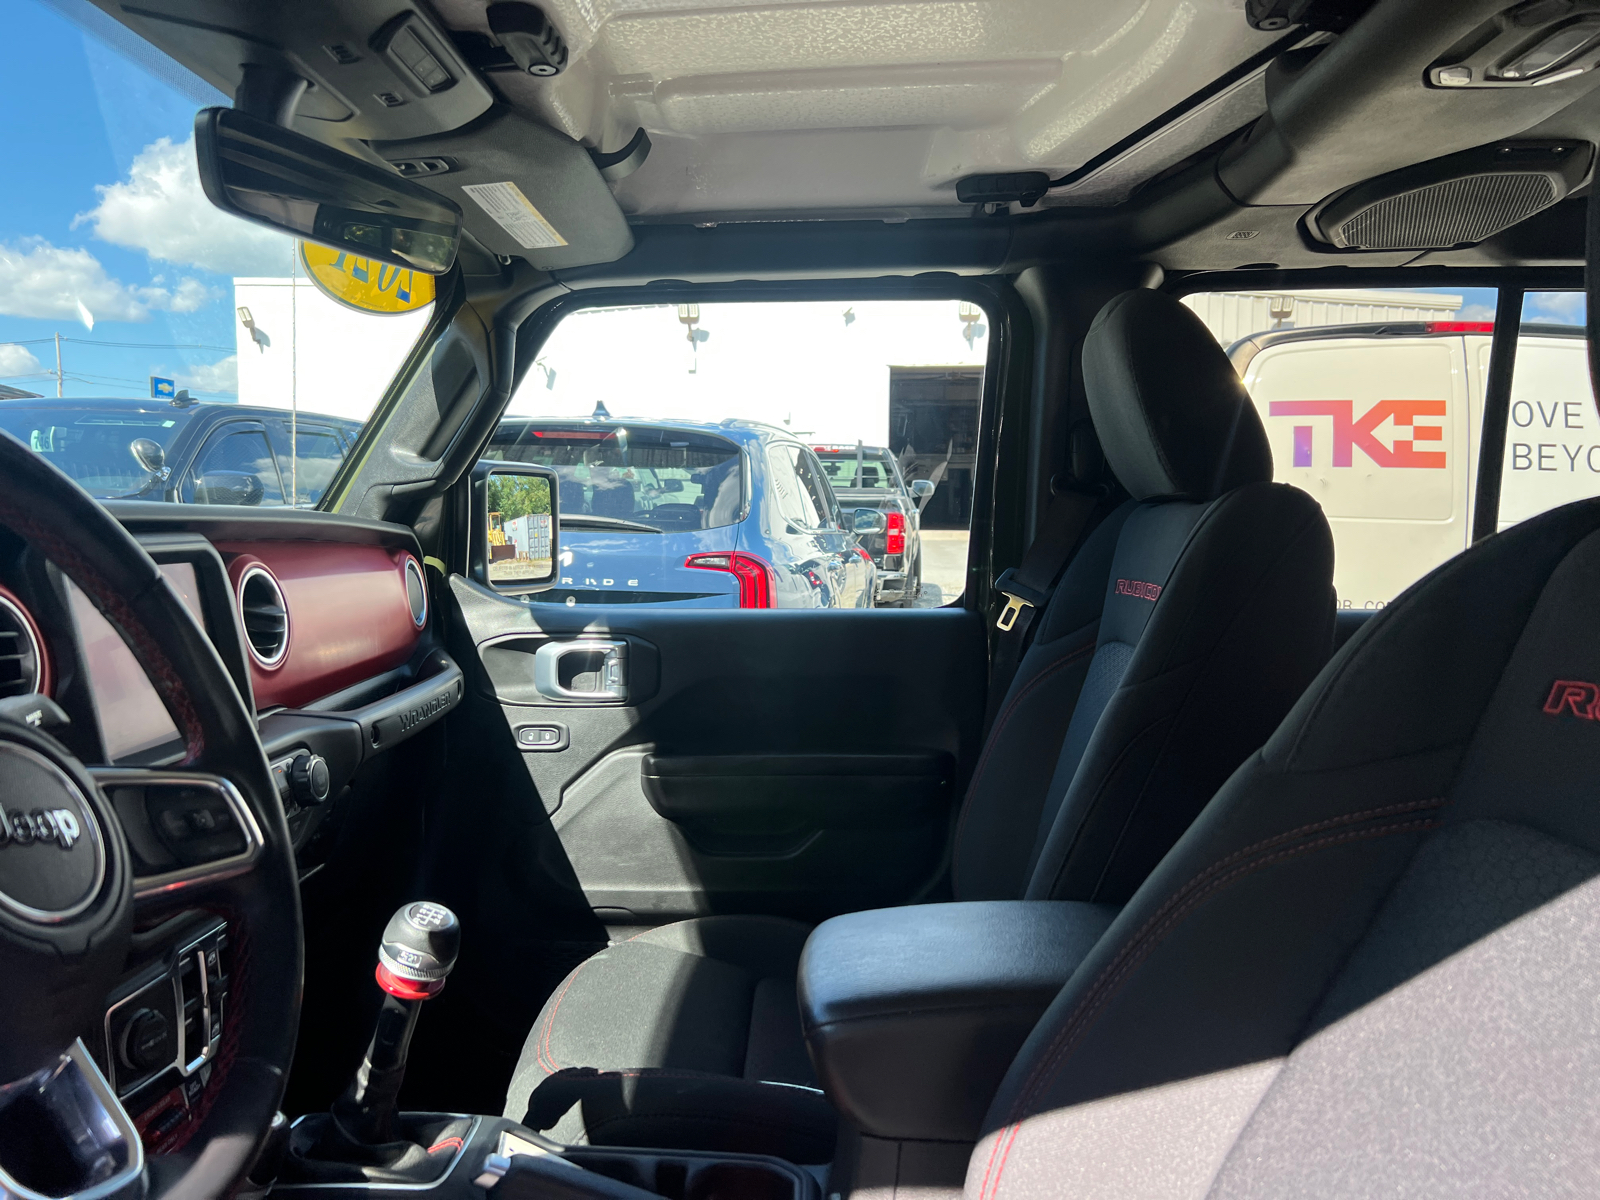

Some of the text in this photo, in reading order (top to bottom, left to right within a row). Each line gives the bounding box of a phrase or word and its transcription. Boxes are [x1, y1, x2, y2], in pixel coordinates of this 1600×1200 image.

[1269, 400, 1447, 468] TKE
[1511, 400, 1584, 429] OVE
[399, 691, 451, 732] WRANGLER
